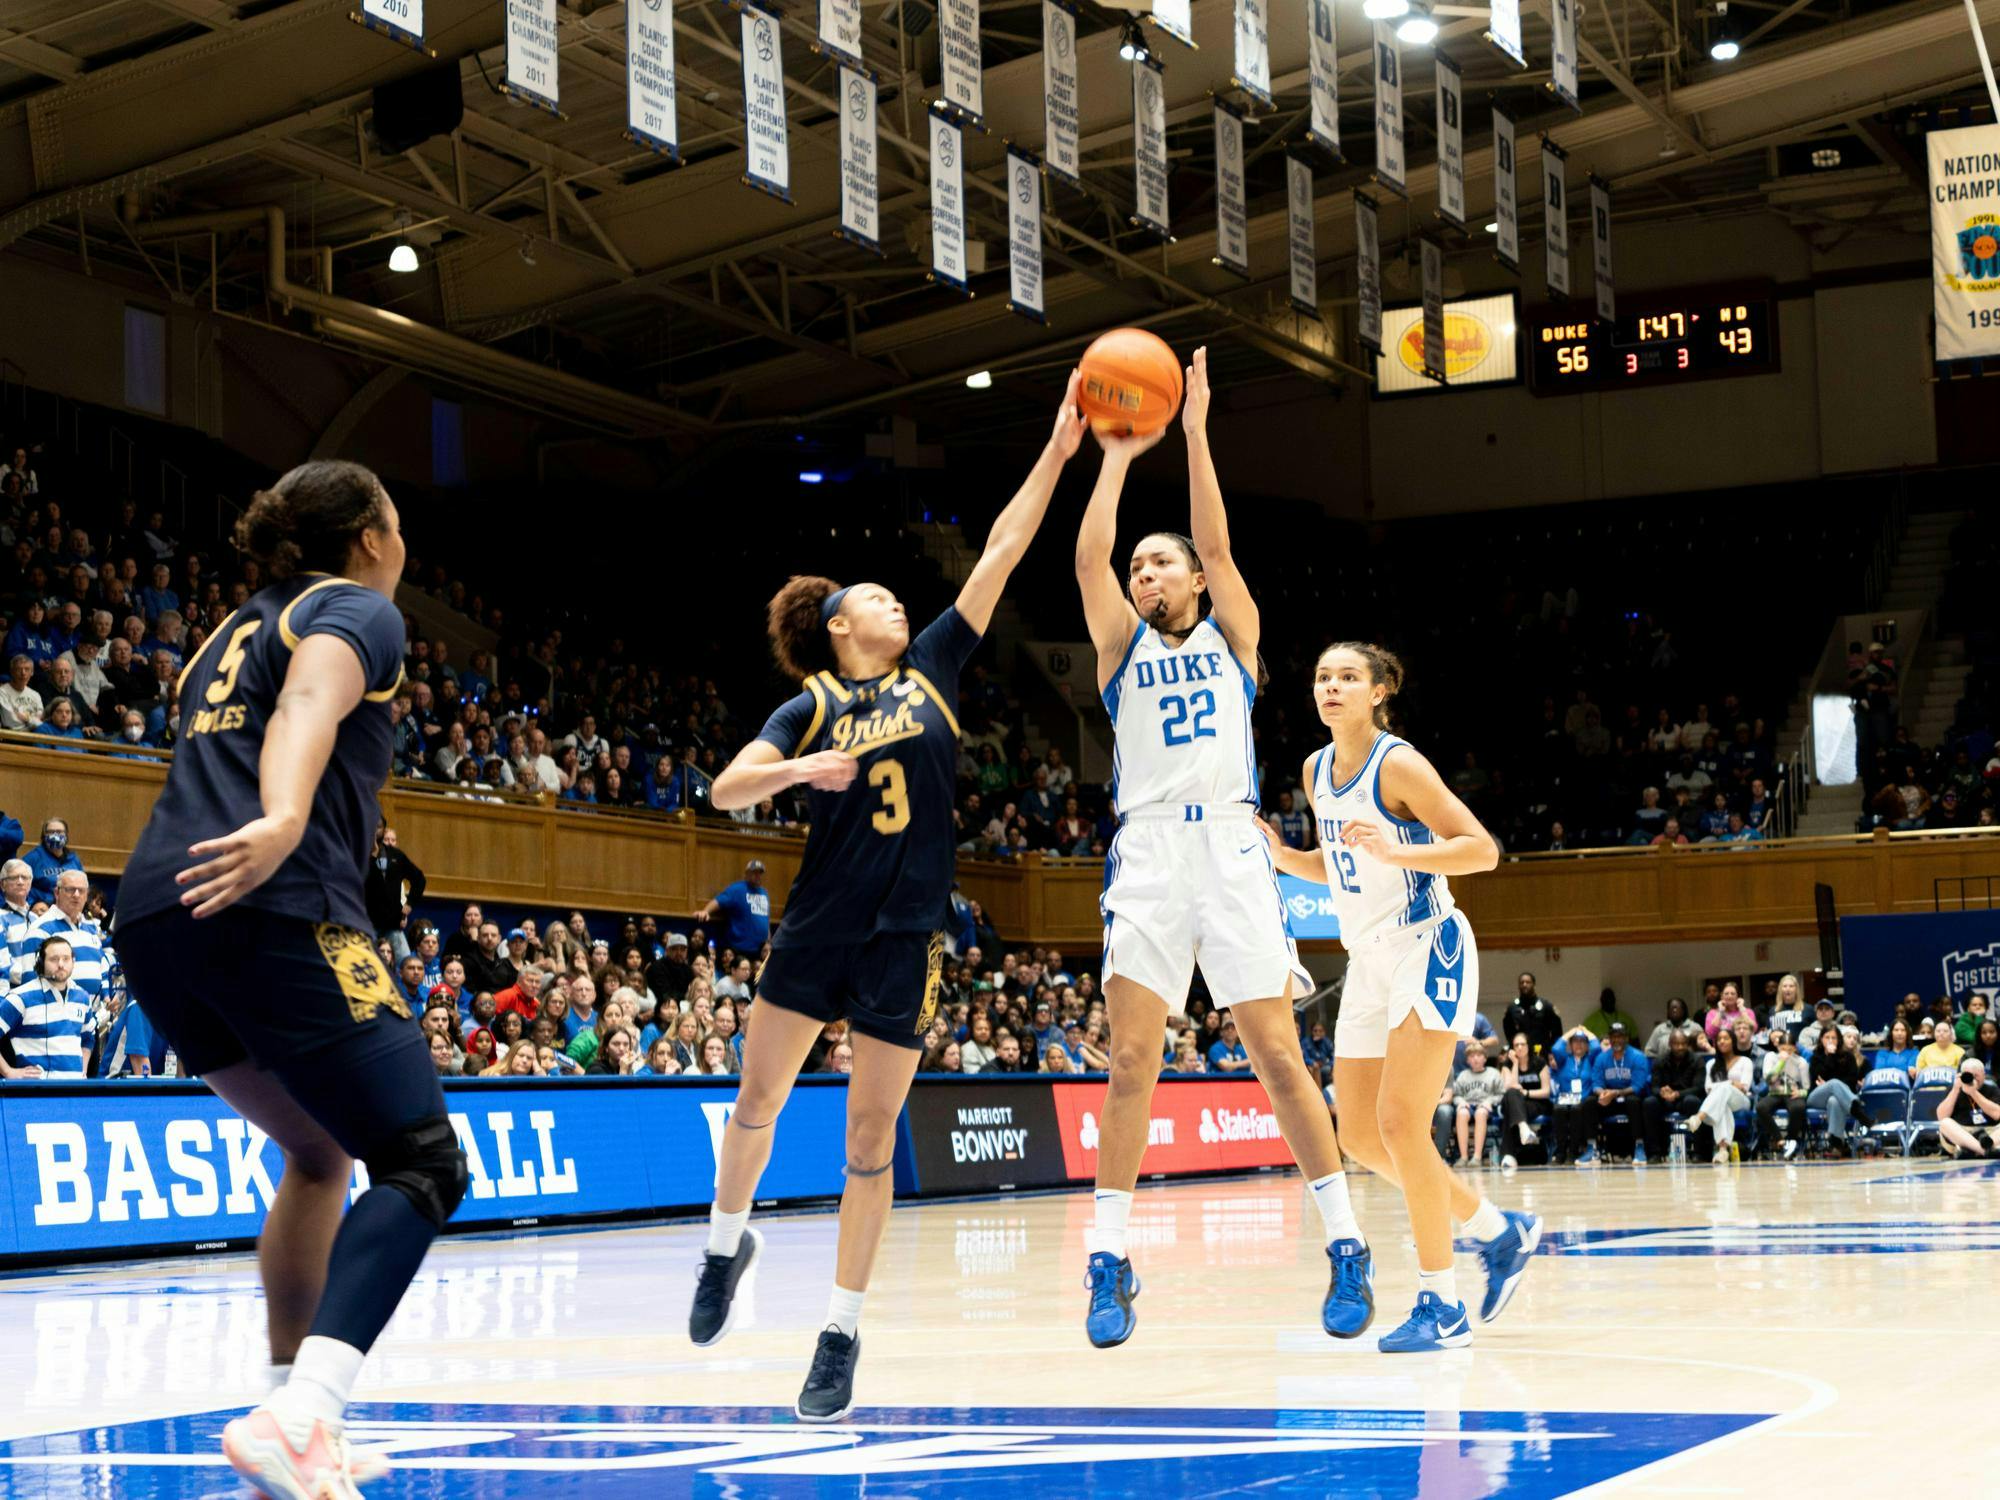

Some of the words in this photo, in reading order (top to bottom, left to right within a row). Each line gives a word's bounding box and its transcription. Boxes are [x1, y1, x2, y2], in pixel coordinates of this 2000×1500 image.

[512, 20, 556, 53] CHAMPIONS
[642, 41, 663, 62] COAST
[526, 65, 546, 86] 2011
[644, 112, 662, 131] 2017
[1973, 214, 1995, 225] 1991
[1542, 323, 1588, 342] DUKE
[1639, 312, 1685, 341] 1:47
[1719, 327, 1752, 354] 43
[1556, 346, 1589, 374] 56
[1626, 353, 1638, 375] 3
[1678, 347, 1689, 369] 3
[205, 619, 262, 704] 5
[1135, 653, 1223, 689] DUKE
[832, 702, 924, 759] Irish
[1158, 688, 1216, 747] 22
[868, 758, 911, 835] 3
[1331, 849, 1361, 894] 12
[1435, 977, 1457, 1002] D
[1871, 1069, 1901, 1085] DUKE
[957, 1107, 1013, 1126] MARRIOTT
[951, 1129, 1026, 1163] BONVOY
[25, 1110, 579, 1226] BASKALL
[195, 1242, 228, 1251] DAKTRONICS
